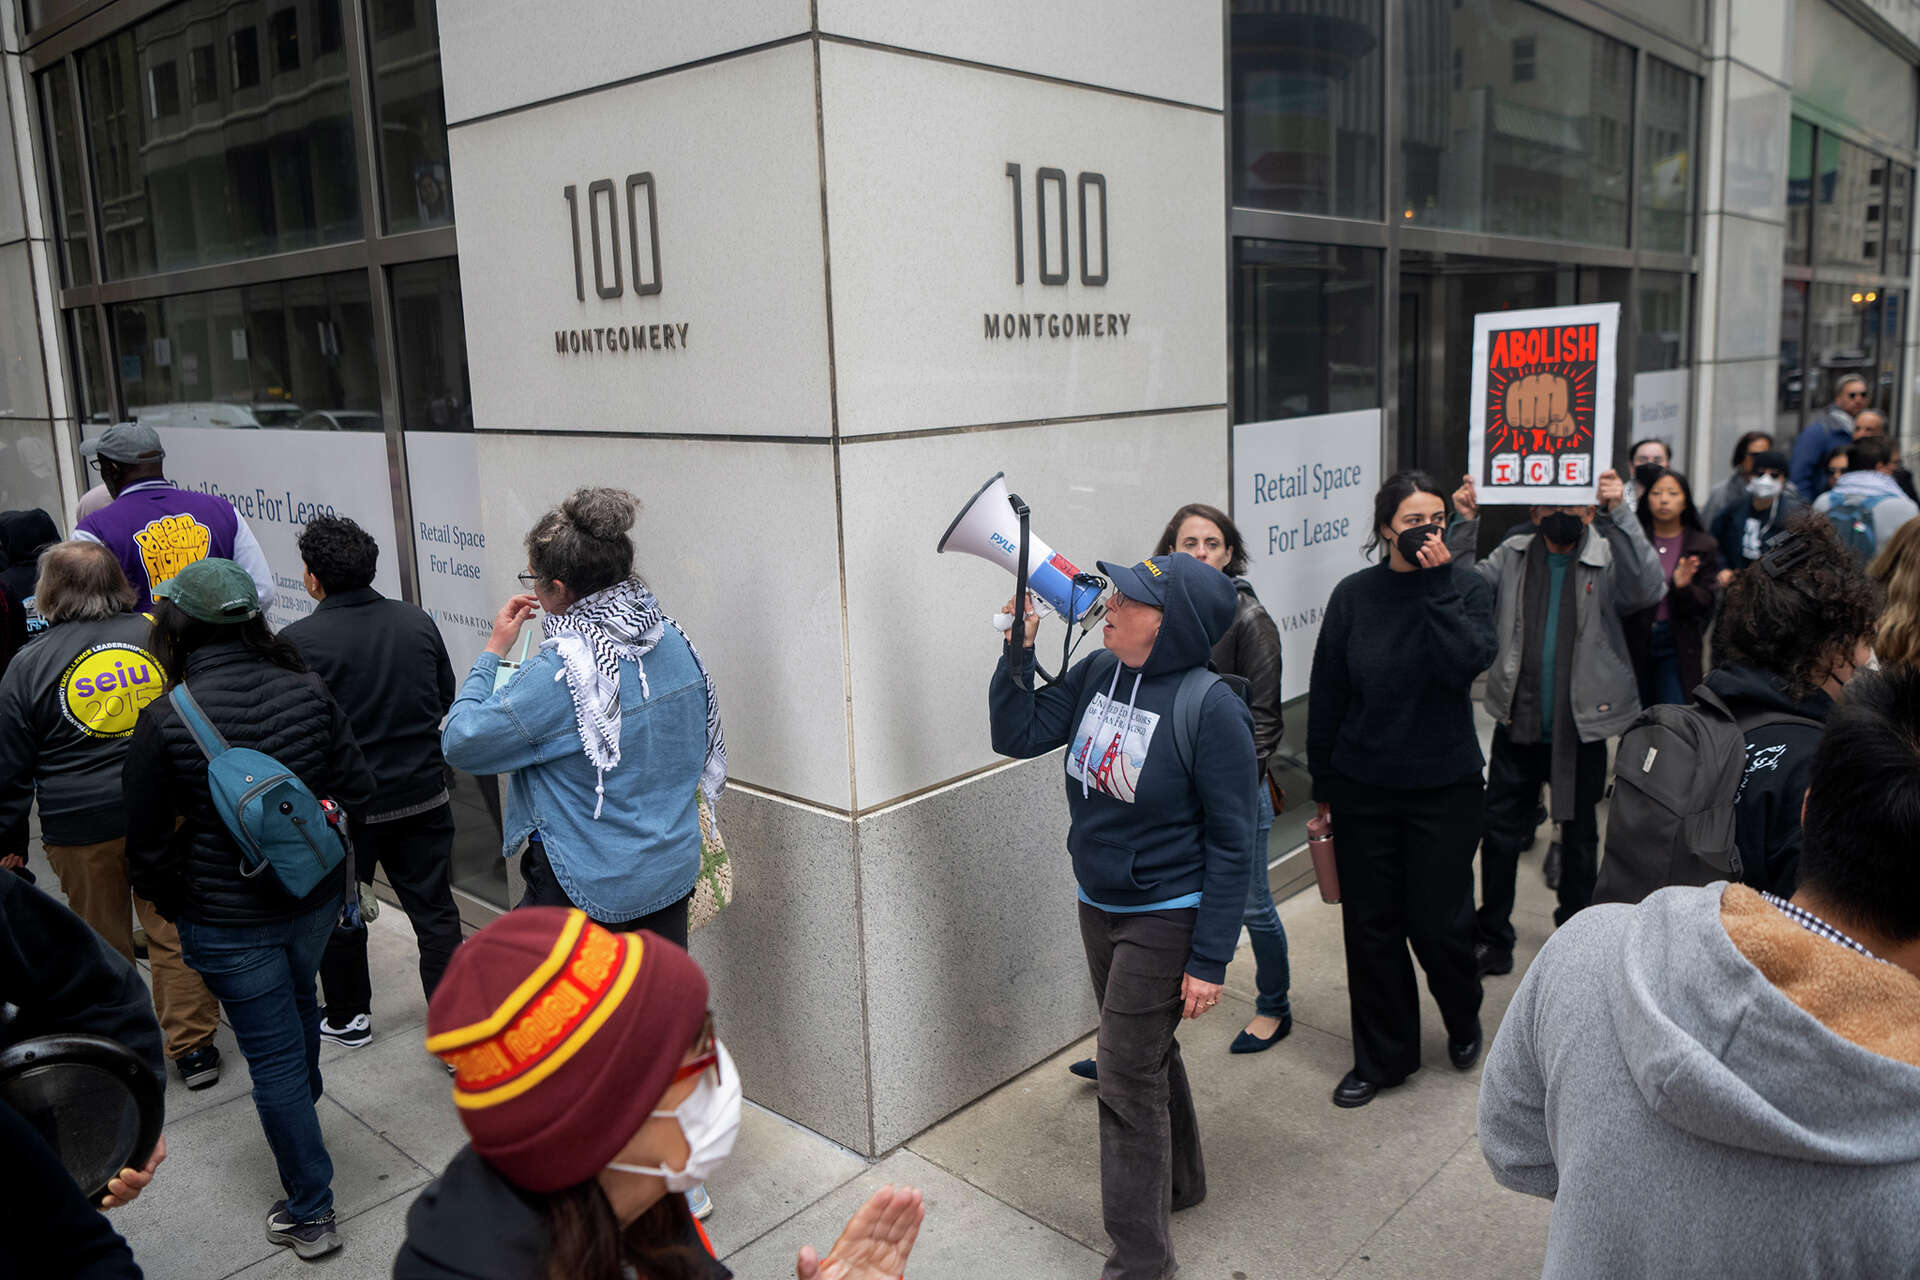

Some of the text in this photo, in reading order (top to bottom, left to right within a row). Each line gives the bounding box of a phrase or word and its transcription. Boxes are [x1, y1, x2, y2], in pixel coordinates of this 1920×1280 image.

[564, 171, 663, 302] 100
[1005, 162, 1109, 287] 100
[555, 323, 688, 353] MONTGOMERY
[984, 313, 1131, 339] MONTGOMERY
[1489, 326, 1597, 368] ABOLISH
[1254, 463, 1361, 504] Retail Space
[256, 489, 282, 521] For
[420, 522, 485, 550] Retail Space
[1268, 516, 1349, 555] For Lease
[430, 554, 480, 580] For Lease
[443, 611, 493, 630] VANBARTON
[92, 642, 140, 652] LEADERSHIP
[75, 661, 150, 698] seiu
[85, 687, 152, 723] 2015
